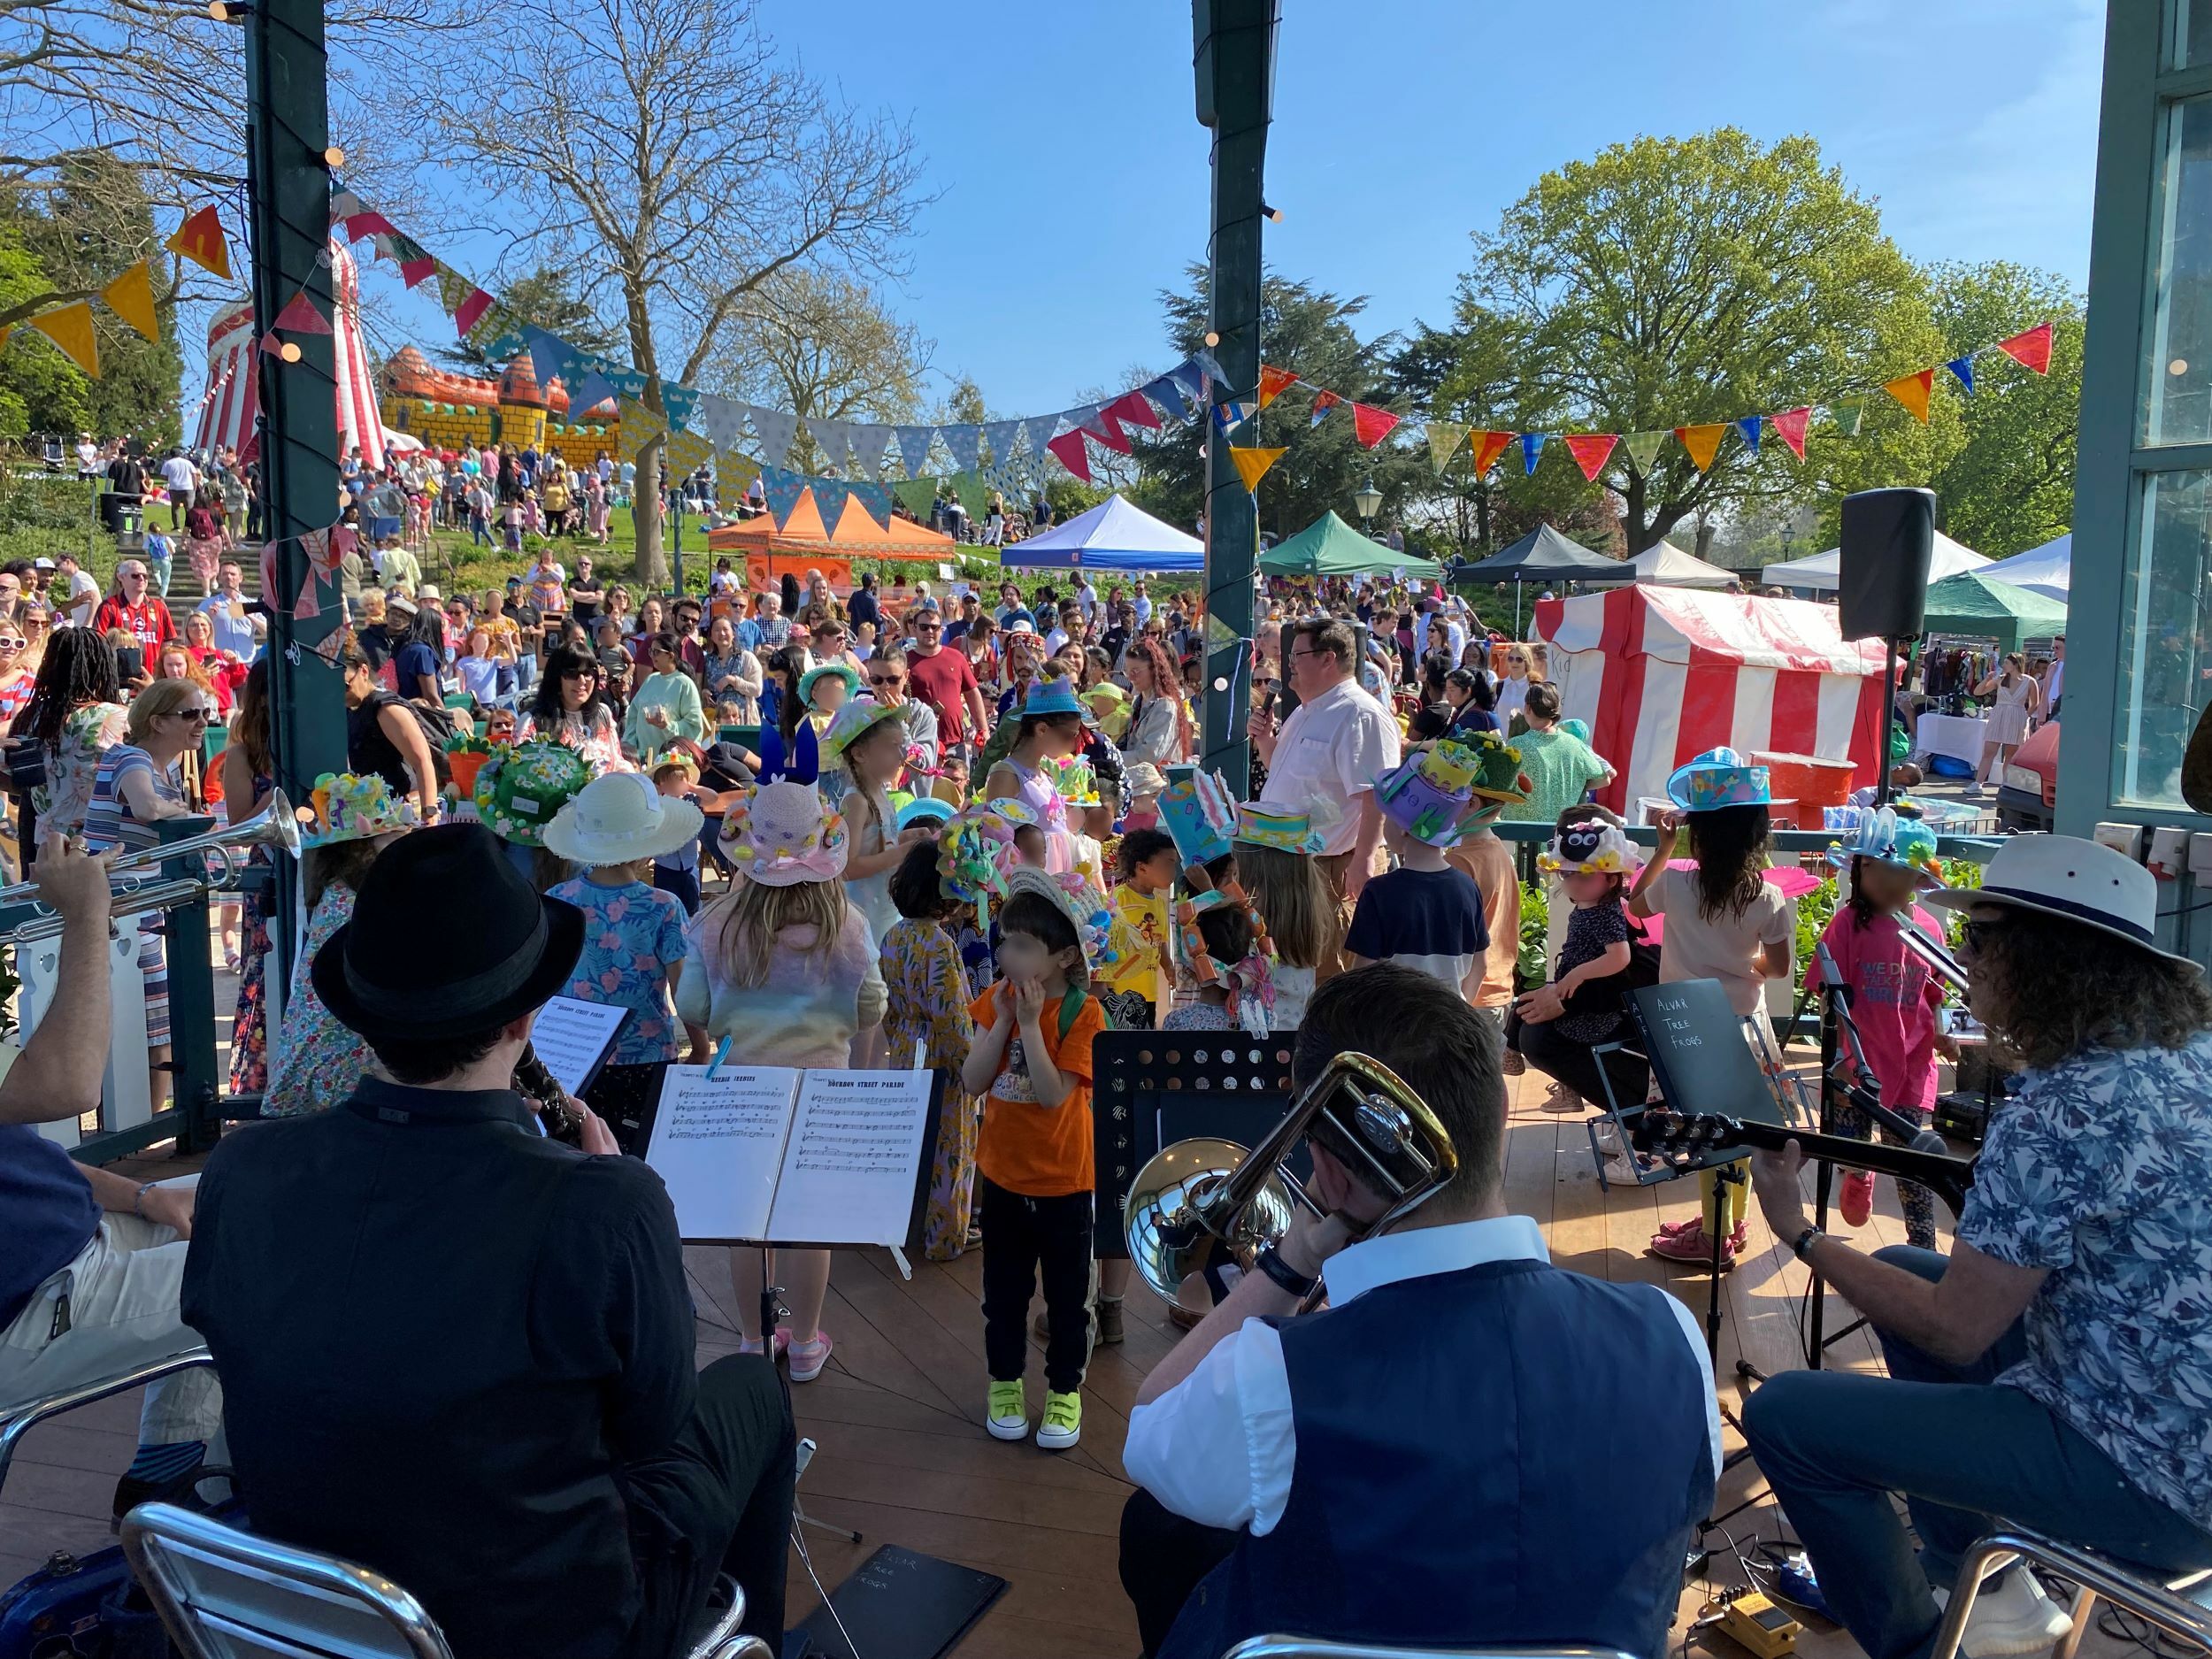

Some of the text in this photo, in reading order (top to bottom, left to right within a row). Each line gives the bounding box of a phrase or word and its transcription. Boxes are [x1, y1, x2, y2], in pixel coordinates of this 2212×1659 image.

[1657, 998, 1689, 1011] ALVAR
[1662, 1018, 1691, 1032] TREE
[1671, 1035, 1702, 1050] FROGS
